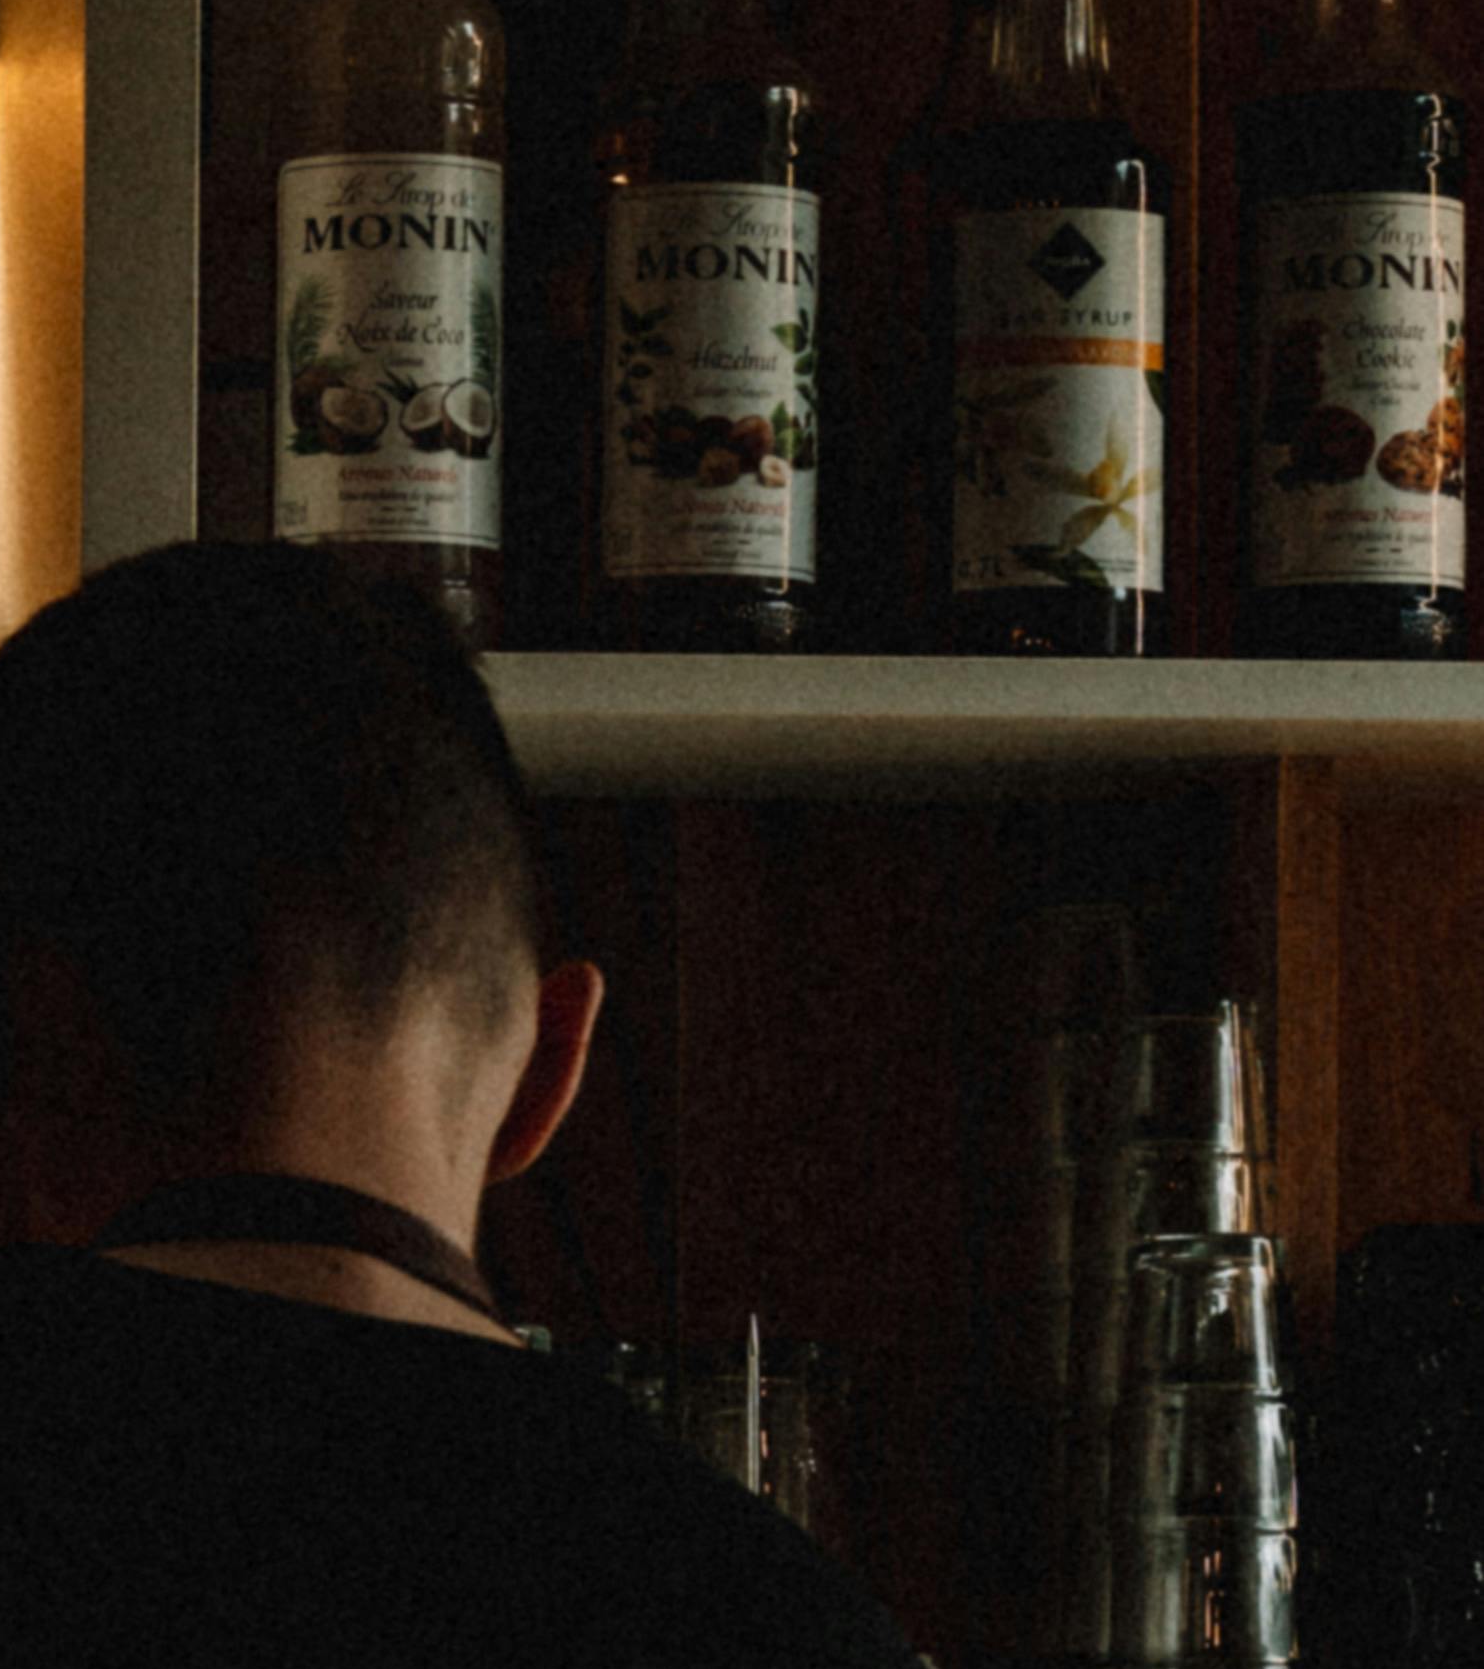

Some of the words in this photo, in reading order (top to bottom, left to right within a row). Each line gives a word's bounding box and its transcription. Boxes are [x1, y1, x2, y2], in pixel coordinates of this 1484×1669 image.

[302, 211, 490, 254] MONIN
[636, 243, 815, 286] MONIN
[1284, 253, 1461, 292] MONIN
